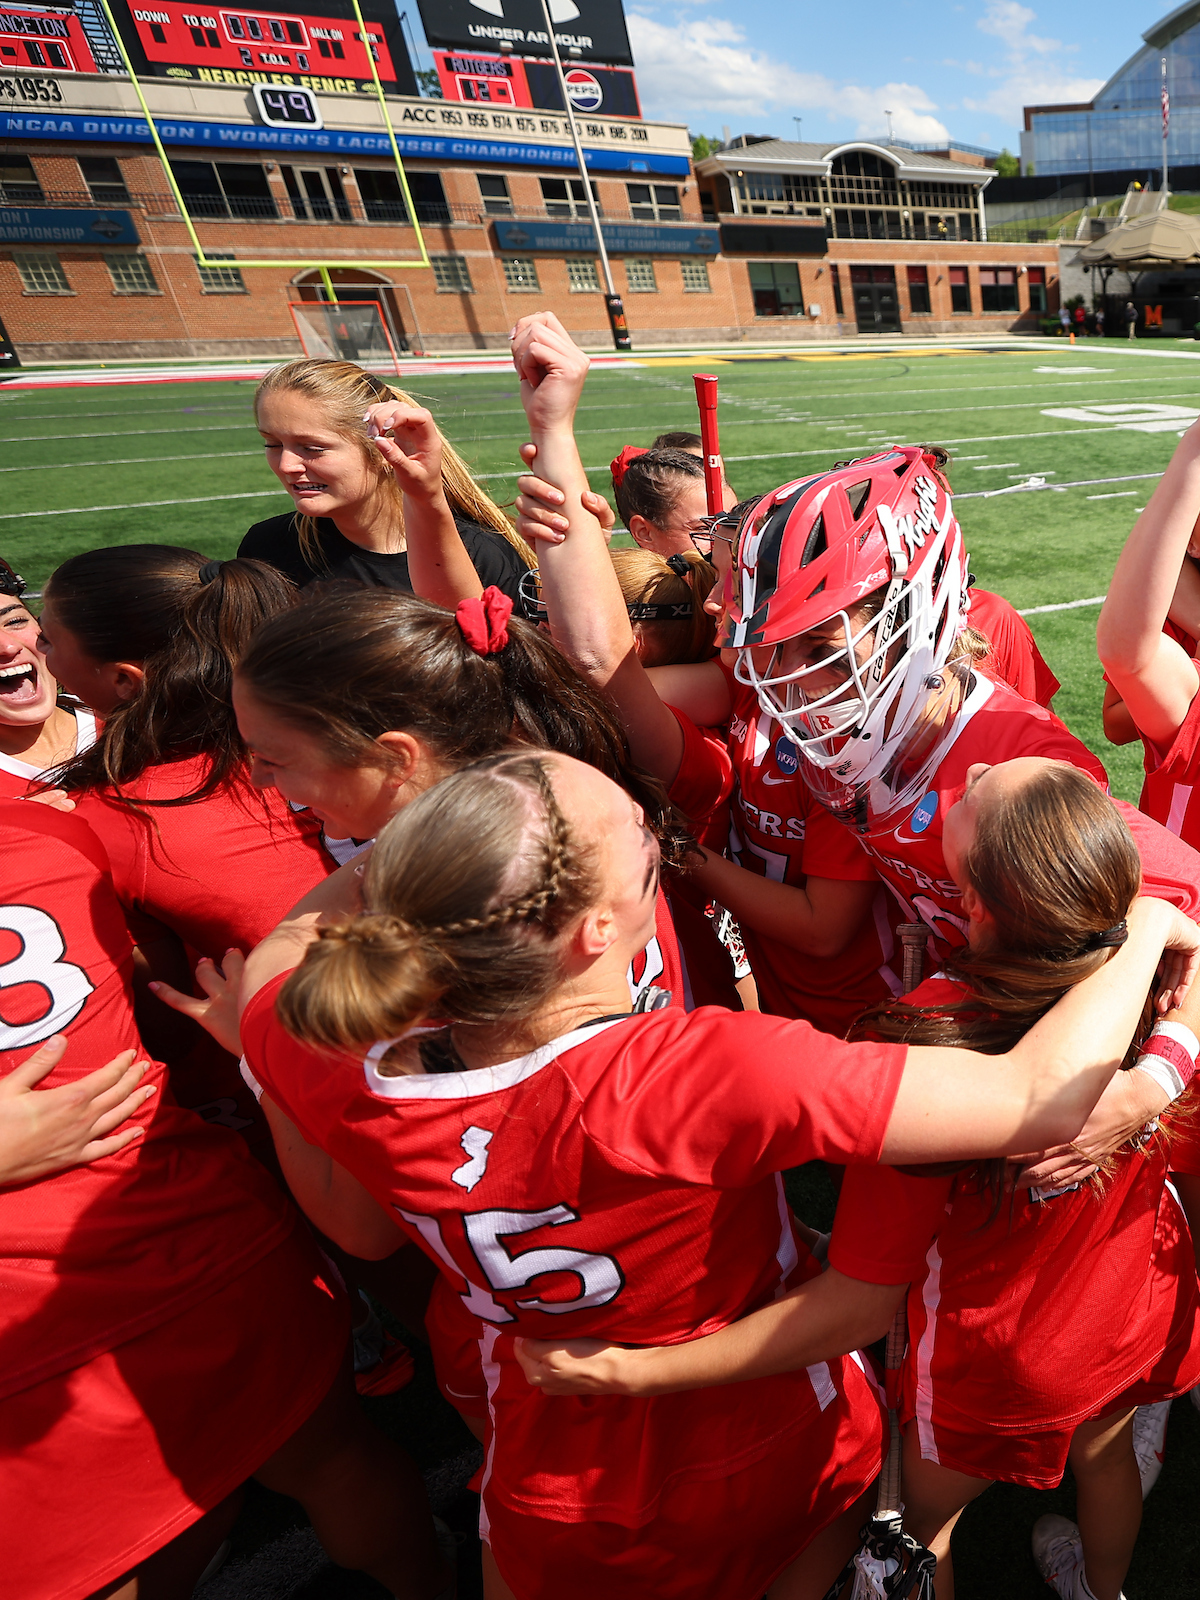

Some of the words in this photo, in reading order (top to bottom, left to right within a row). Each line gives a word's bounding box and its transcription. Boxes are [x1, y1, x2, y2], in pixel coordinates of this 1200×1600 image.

[0, 14, 68, 37] NCETON
[134, 9, 171, 24] DOWN
[182, 14, 199, 27] TO
[200, 17, 217, 29] GO
[309, 27, 331, 40] BALL
[331, 29, 345, 41] ON
[468, 24, 526, 42] UNDER
[238, 47, 254, 66] 2
[295, 52, 311, 71] 0
[451, 58, 508, 76] RUTGERS
[16, 77, 63, 101] 1953
[300, 75, 357, 93] FENCE
[567, 84, 600, 95] PEPSI
[265, 93, 313, 121] 49
[403, 108, 436, 123] ACC
[441, 110, 463, 125] 1953
[564, 121, 583, 136] 193
[7, 118, 75, 133] NCAA
[83, 122, 196, 139] DIVISON
[219, 130, 331, 147] WOMEN'S
[452, 143, 593, 163] CHAMPIONSHP
[0, 211, 20, 224] ON
[1145, 304, 1163, 328] M
[872, 587, 899, 683] cacade
[816, 715, 835, 730] R
[395, 1203, 625, 1325] 15
